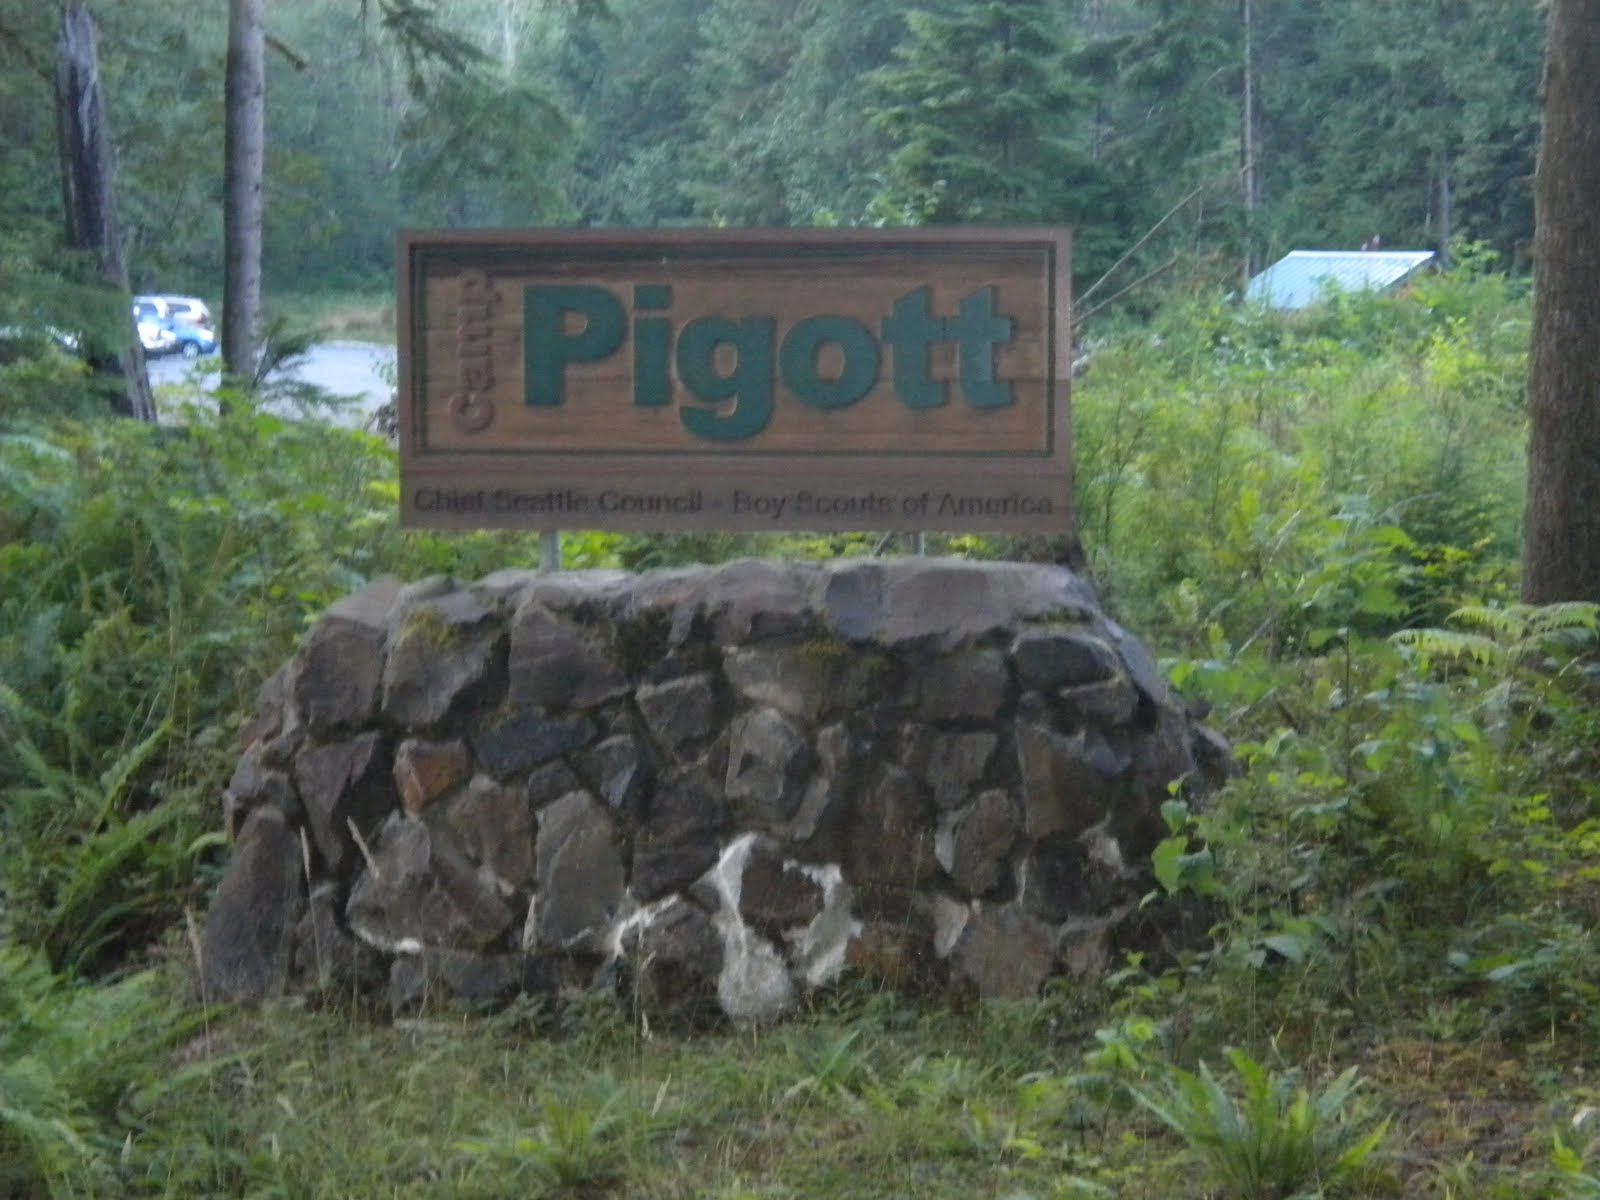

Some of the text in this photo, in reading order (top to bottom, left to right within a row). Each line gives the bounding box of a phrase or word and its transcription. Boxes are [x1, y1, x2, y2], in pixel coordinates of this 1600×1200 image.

[523, 283, 1015, 440] Pigott
[415, 488, 482, 512] Chief
[496, 488, 587, 513] Seattle
[600, 488, 703, 513] Council
[733, 490, 787, 518] Boy
[796, 490, 892, 516] Scouts
[902, 491, 928, 516] of
[938, 494, 1051, 517] America
